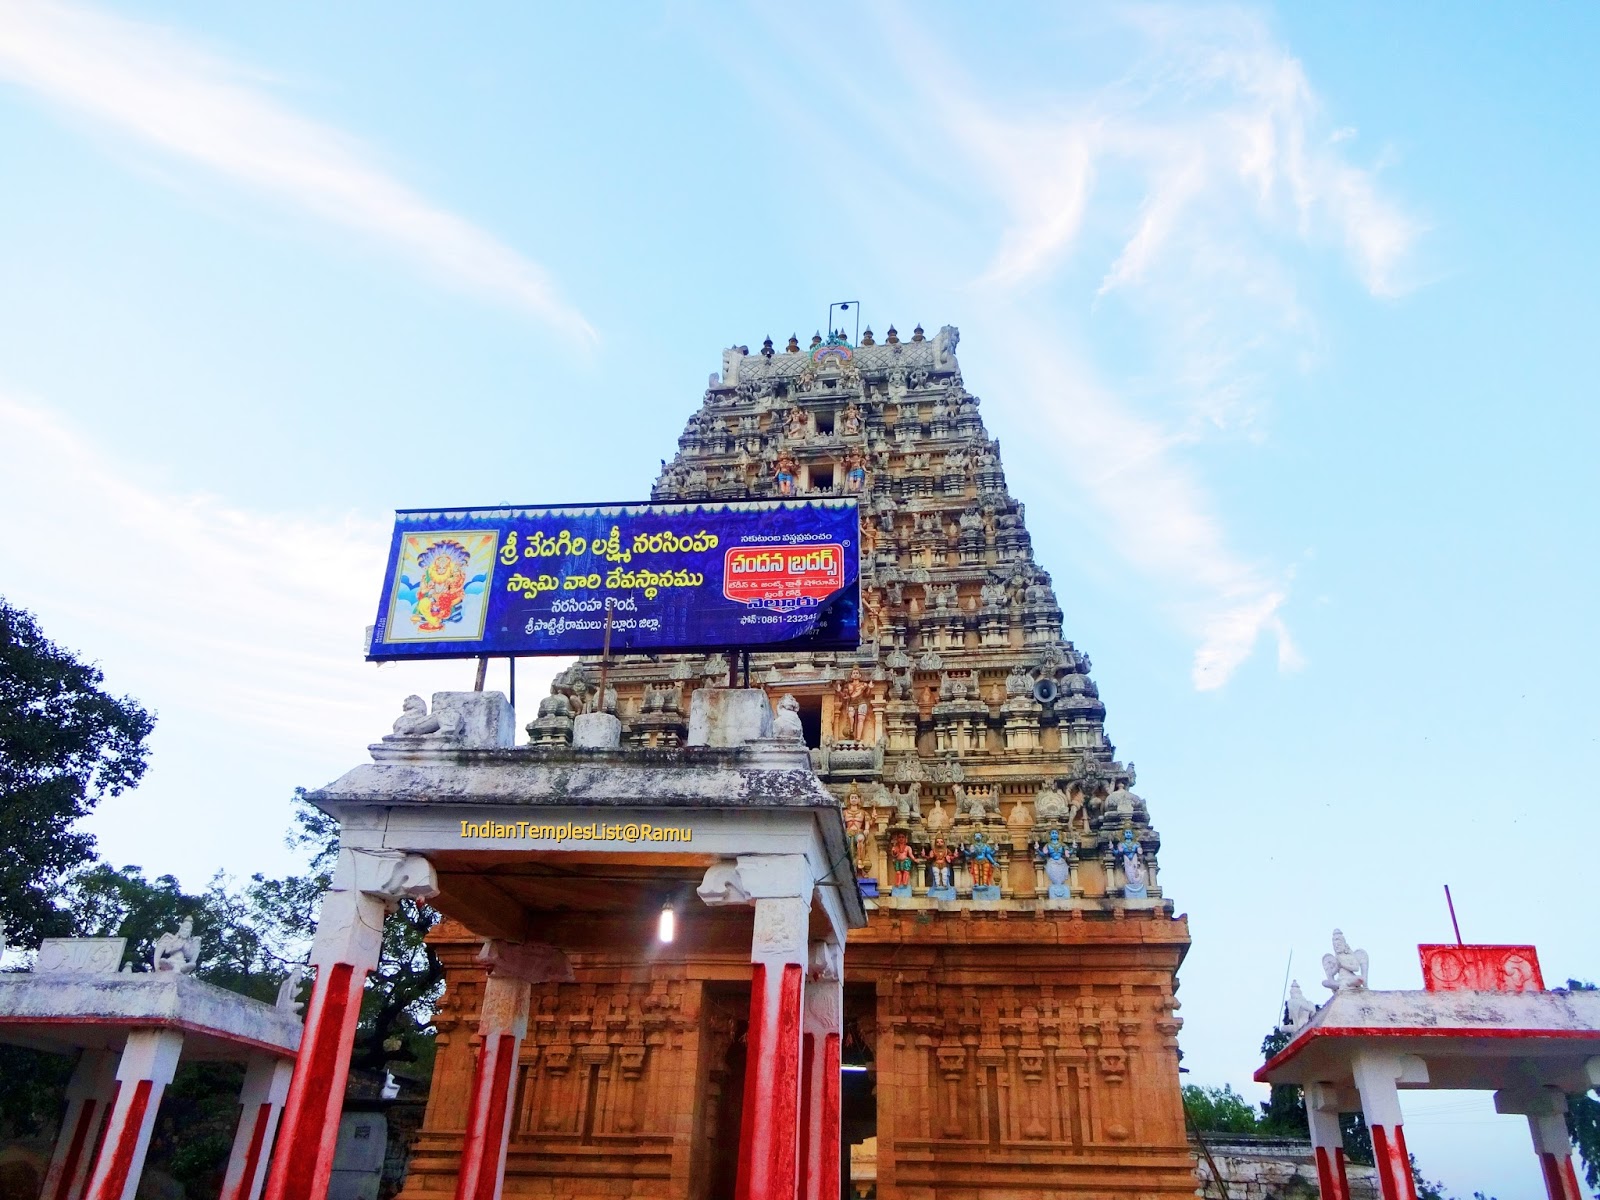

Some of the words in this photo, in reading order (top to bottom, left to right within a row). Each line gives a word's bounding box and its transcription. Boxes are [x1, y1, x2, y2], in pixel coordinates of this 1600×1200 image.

[499, 530, 519, 565] శ్రీ
[523, 530, 587, 558] వేదగిరి
[591, 525, 632, 564] లక్ష్మీ
[633, 530, 719, 555] నరసింహ
[731, 553, 784, 573] చందన
[788, 549, 838, 576] బ్రదర్స్
[506, 573, 559, 599] స్వామి
[563, 572, 602, 591] వారి
[605, 566, 704, 600] దేవస్థానము
[551, 598, 602, 614] నరసింహ
[747, 596, 818, 610] నెల్లూరు
